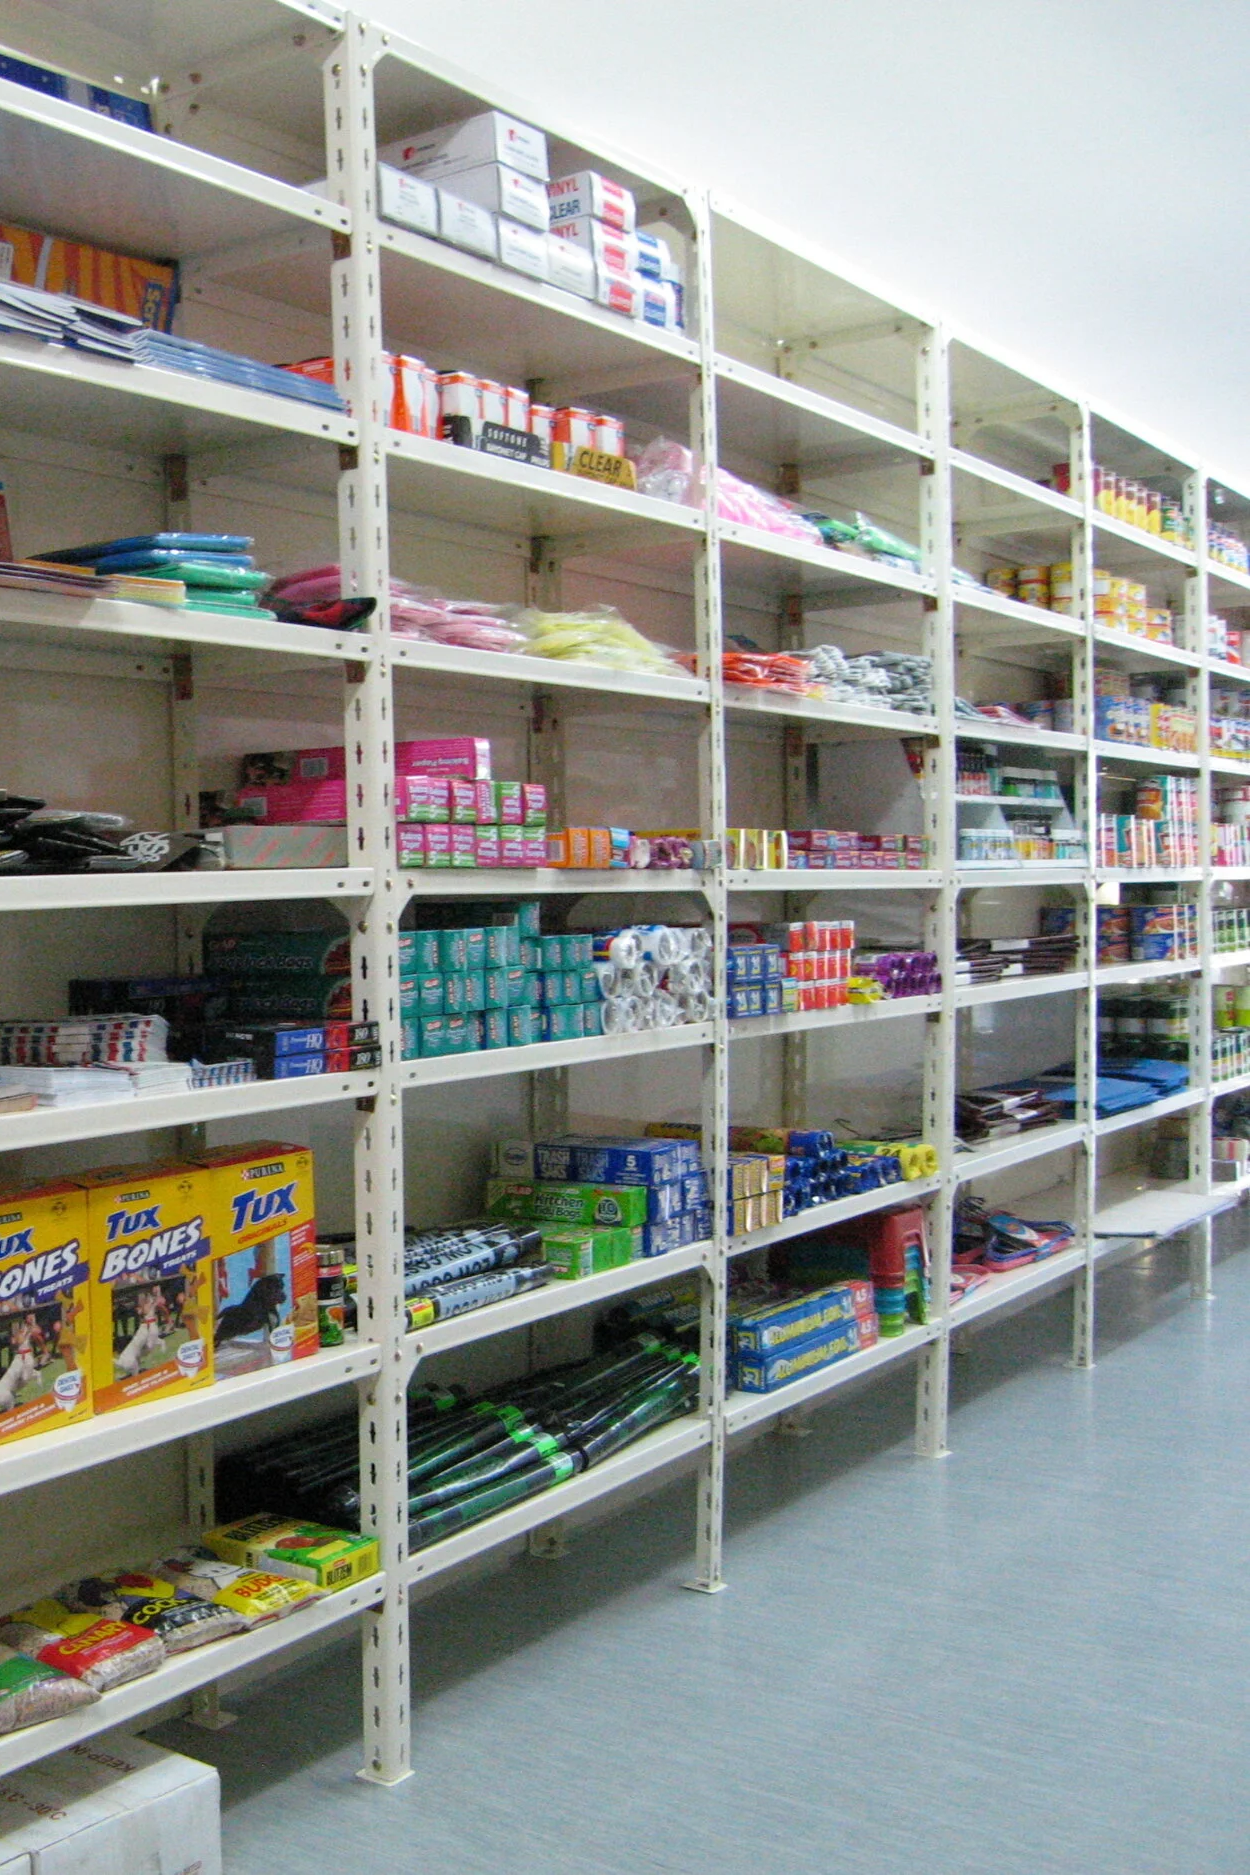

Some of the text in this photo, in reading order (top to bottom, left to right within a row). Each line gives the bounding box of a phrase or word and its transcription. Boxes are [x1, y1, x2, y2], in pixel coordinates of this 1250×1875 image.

[579, 450, 623, 475] CLEAR
[249, 1163, 285, 1178] PURINA
[626, 1155, 636, 1168] 5
[534, 1193, 584, 1209] Kitchen
[556, 1207, 582, 1220] Bags
[100, 1217, 202, 1283] BONES
[162, 1251, 198, 1270] TREATS
[36, 1275, 74, 1297] TREATS
[58, 1620, 129, 1656] CANARY
